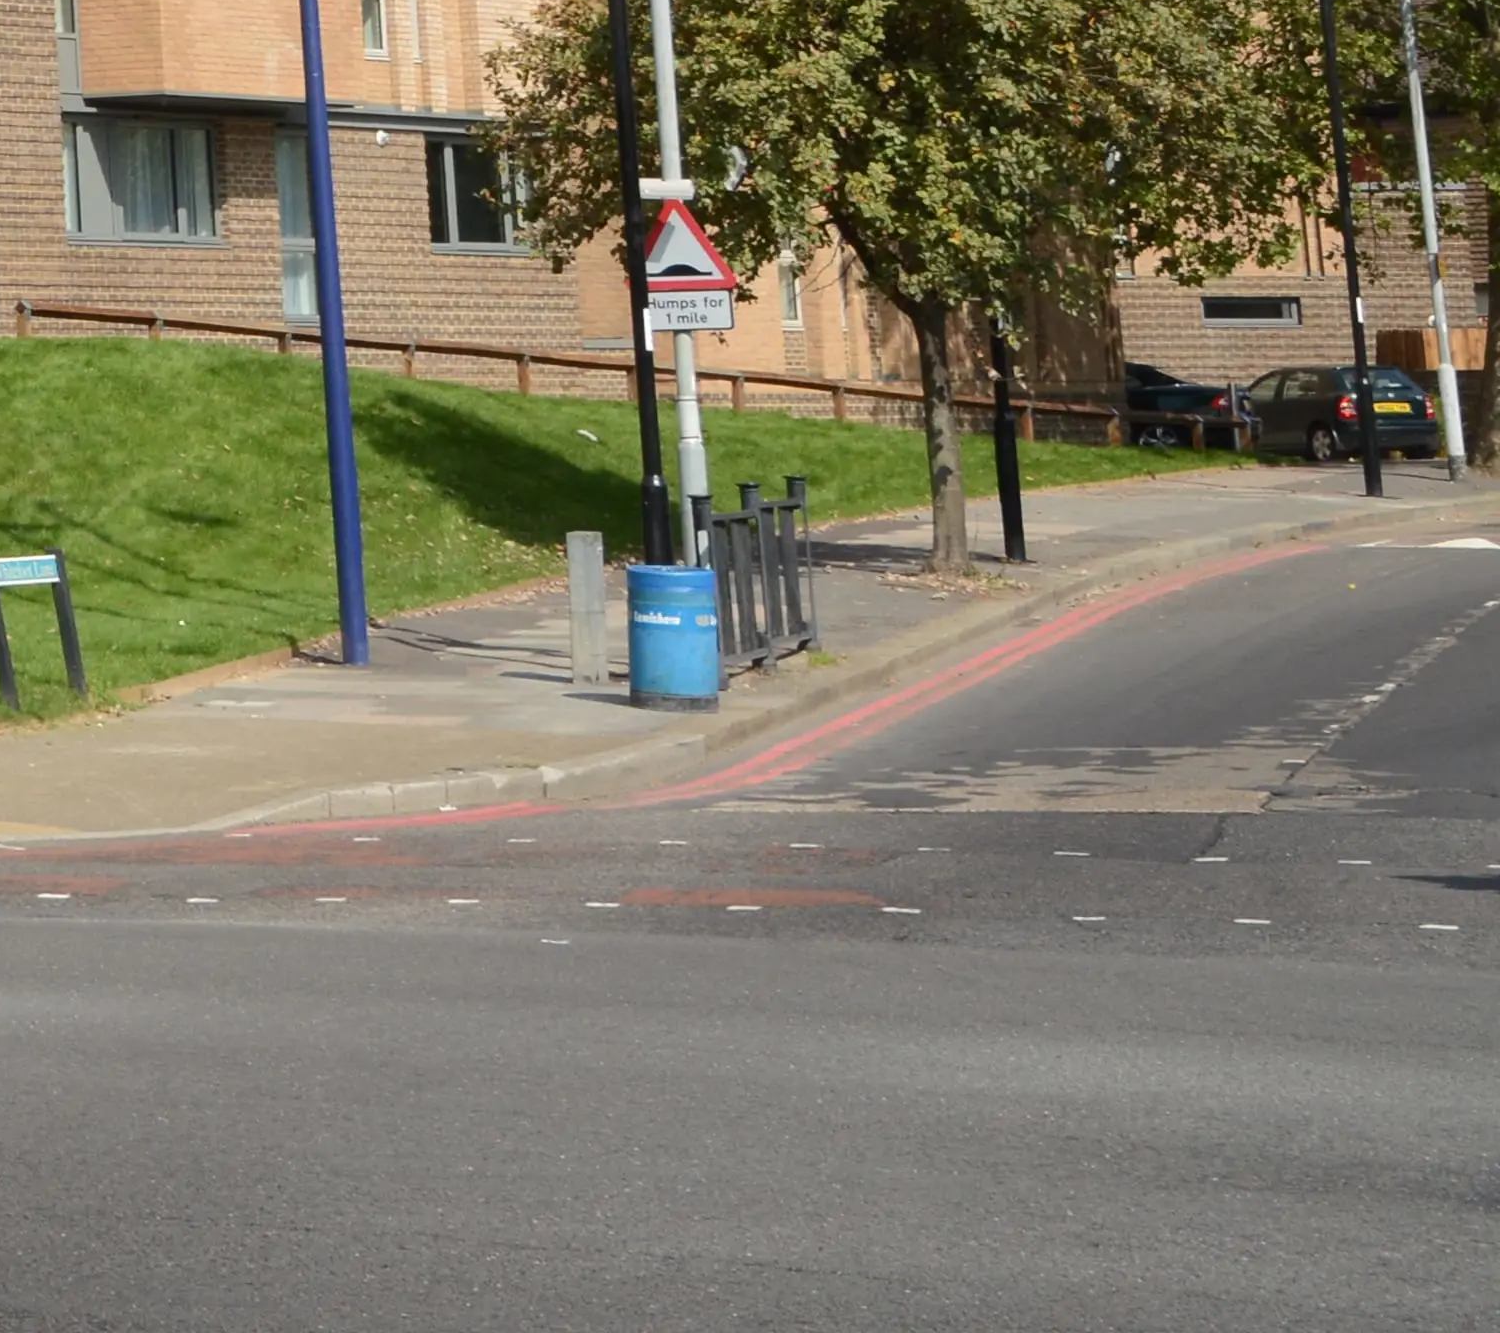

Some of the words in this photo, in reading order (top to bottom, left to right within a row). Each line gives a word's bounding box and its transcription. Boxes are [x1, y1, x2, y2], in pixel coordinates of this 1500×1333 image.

[703, 297, 725, 308] for
[666, 313, 672, 324] 1
[677, 312, 708, 324] mile
